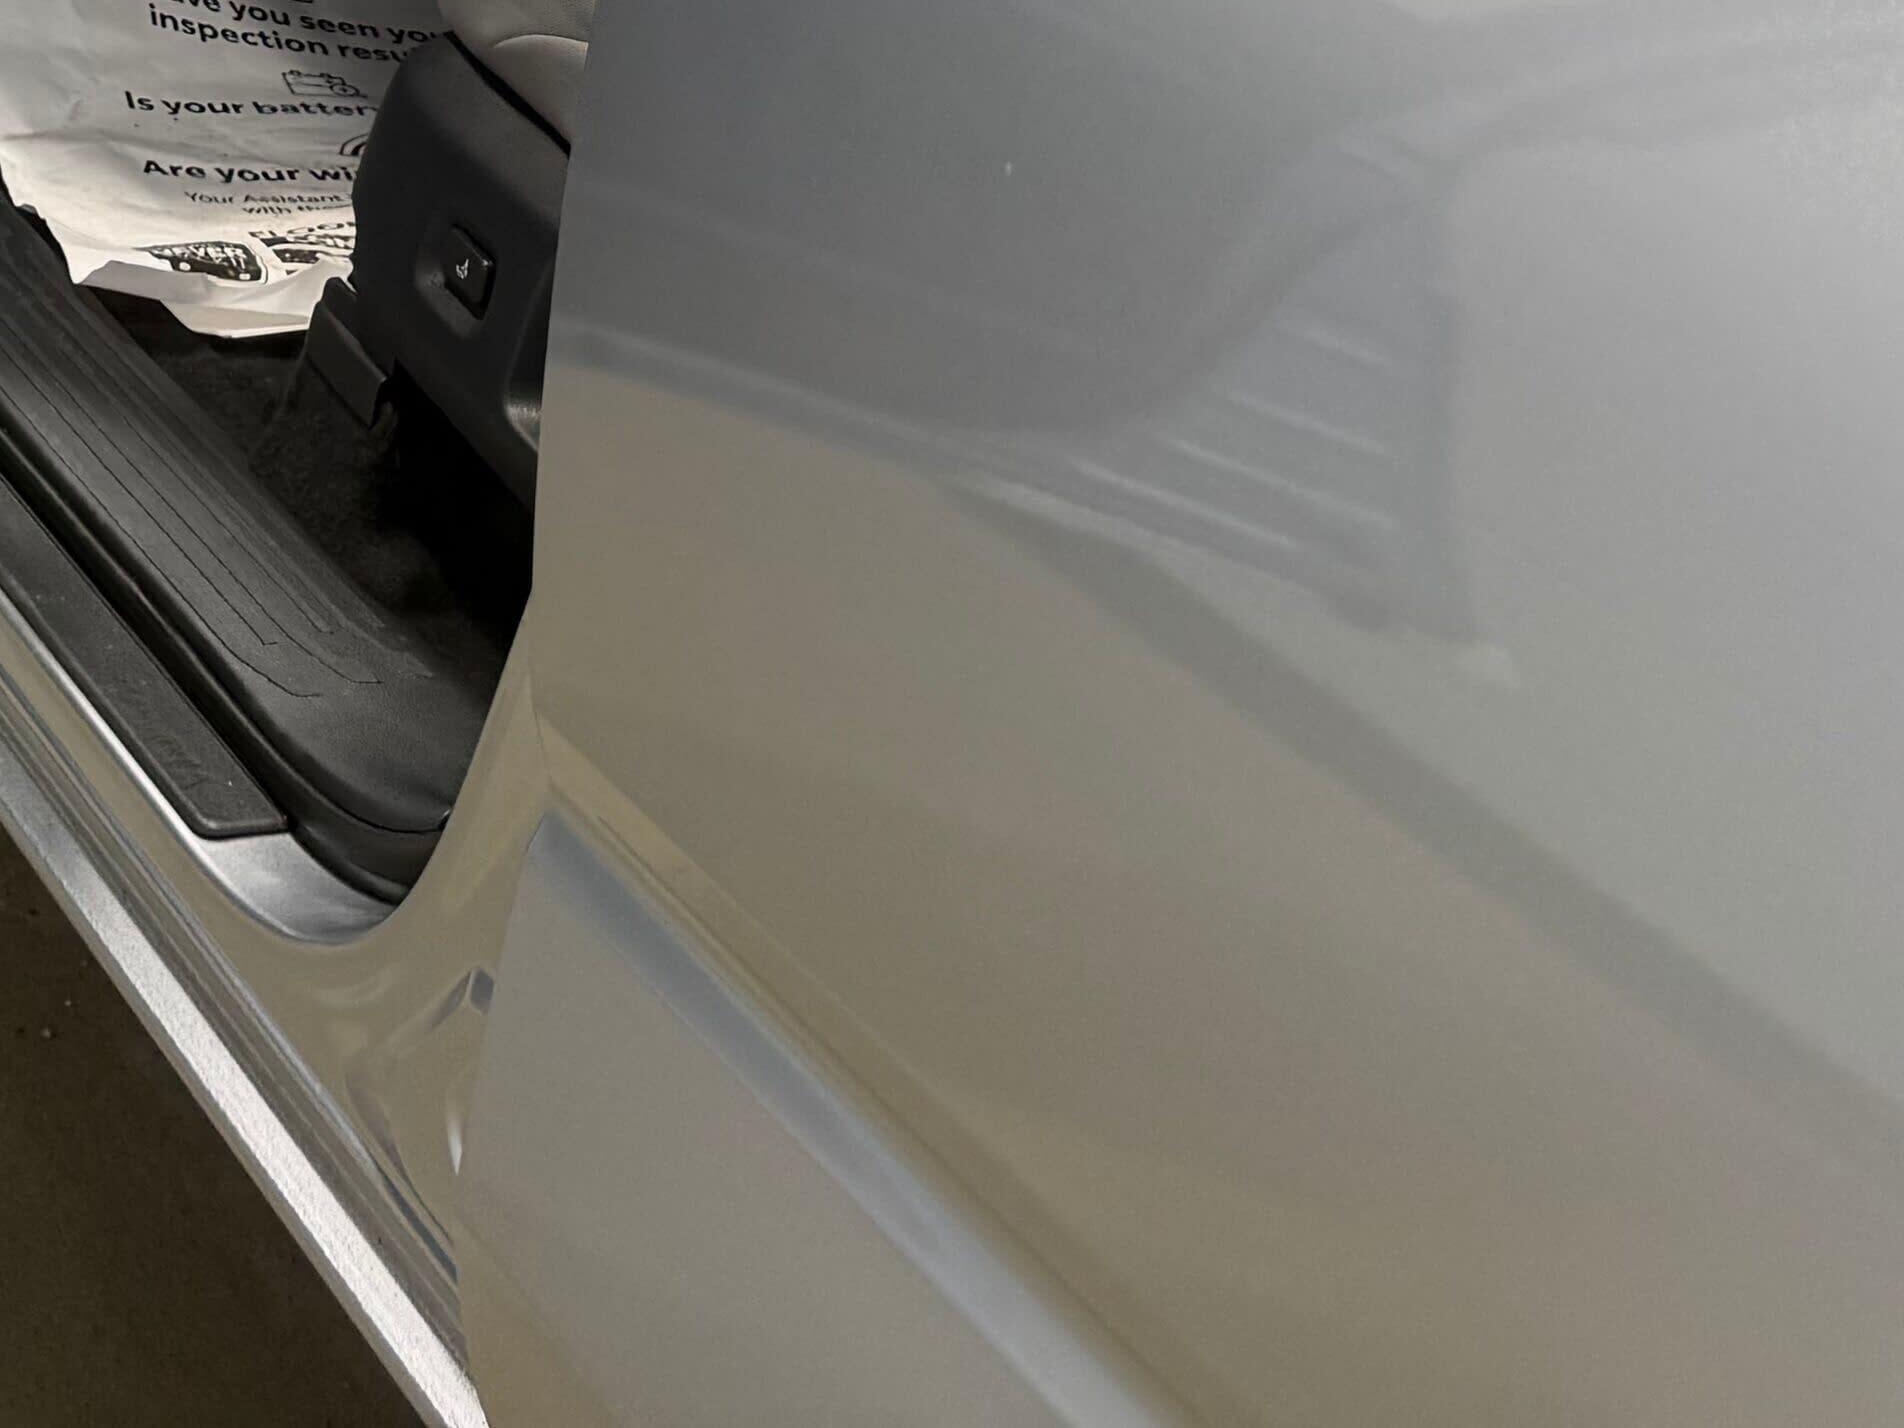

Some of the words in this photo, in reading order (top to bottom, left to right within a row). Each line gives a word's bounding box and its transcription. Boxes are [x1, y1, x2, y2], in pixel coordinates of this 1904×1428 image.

[149, 3, 329, 56] inspection
[229, 1, 291, 27] you
[300, 15, 379, 39] seen
[386, 27, 437, 45] yo
[124, 90, 155, 112] Is
[161, 99, 244, 116] your
[252, 101, 380, 116] batter
[143, 159, 207, 179] Are
[214, 166, 301, 184] your
[308, 166, 354, 182] wi
[184, 191, 235, 204] Your
